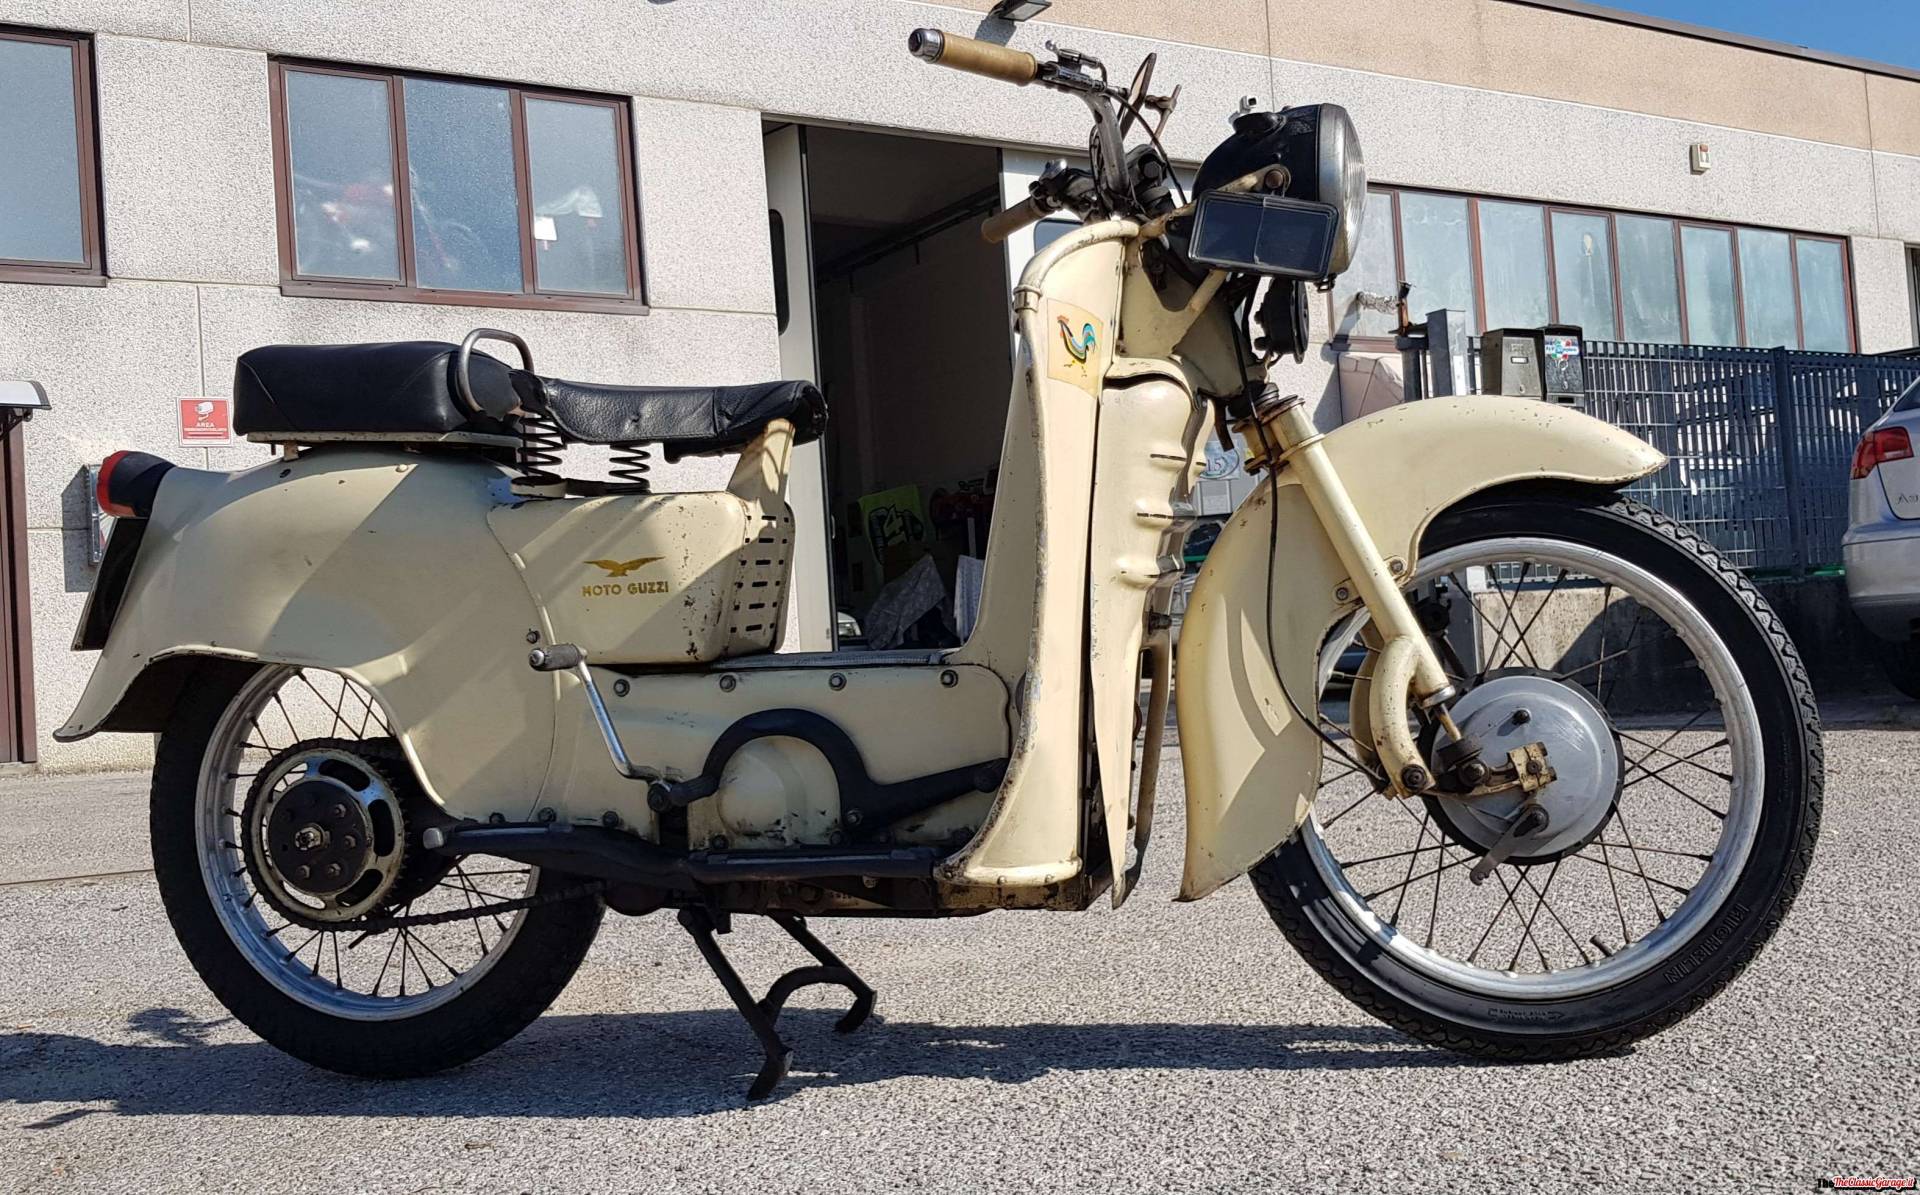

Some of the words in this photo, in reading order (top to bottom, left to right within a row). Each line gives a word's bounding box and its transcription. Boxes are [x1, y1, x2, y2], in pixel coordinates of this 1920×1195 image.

[582, 584, 622, 597] MOTO
[627, 581, 669, 595] GUZZI
[1663, 903, 1750, 984] MICHELIN
